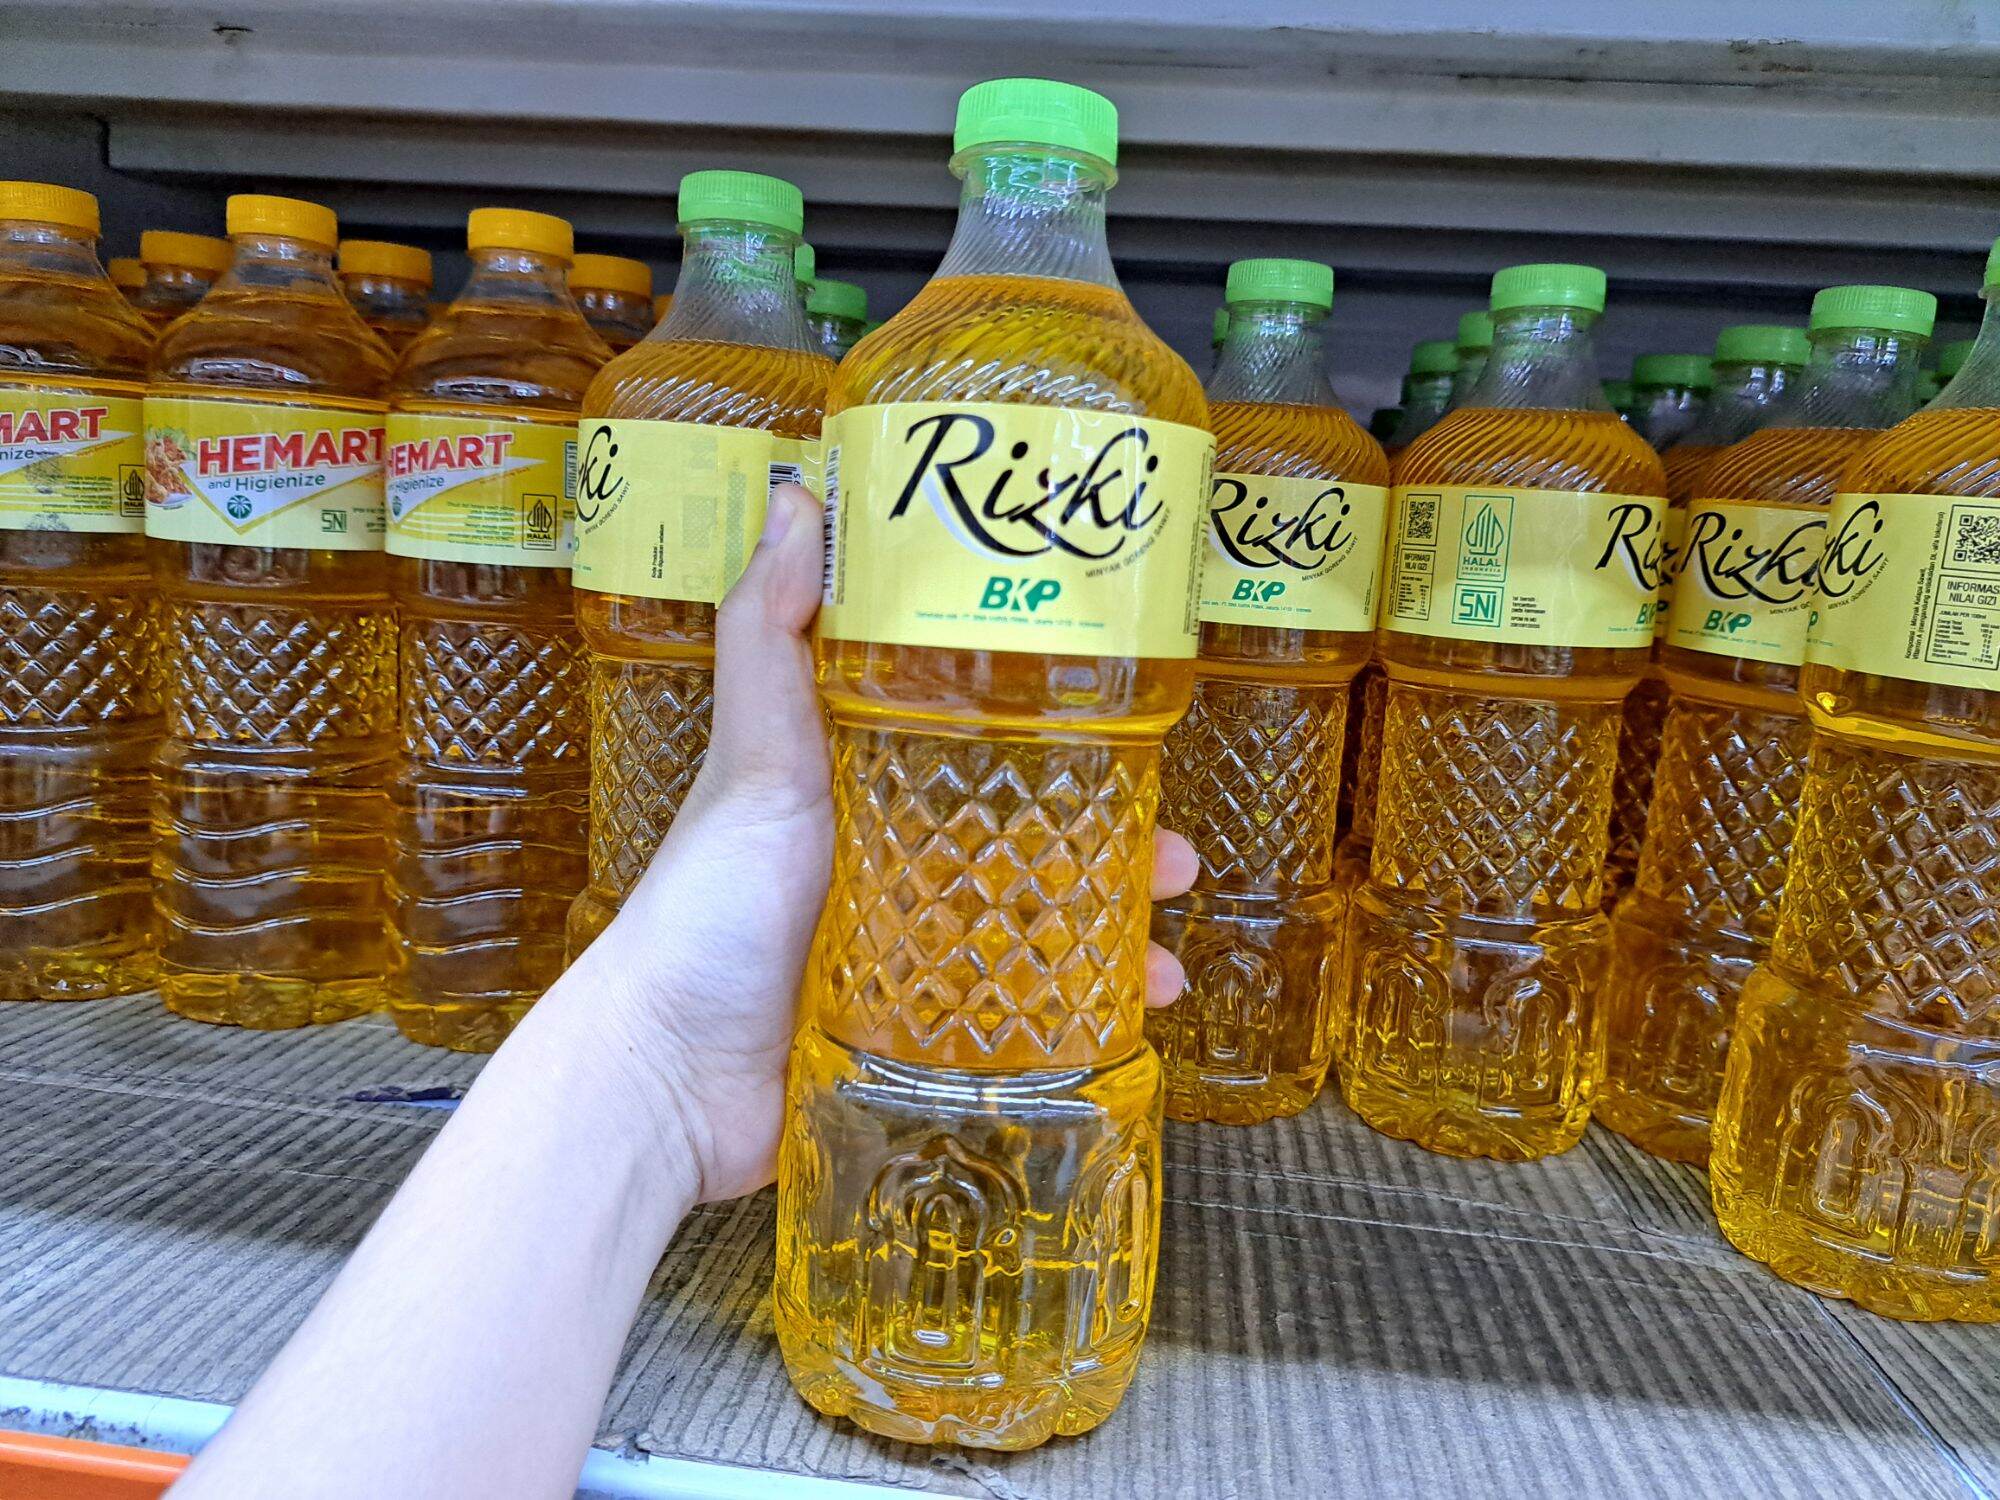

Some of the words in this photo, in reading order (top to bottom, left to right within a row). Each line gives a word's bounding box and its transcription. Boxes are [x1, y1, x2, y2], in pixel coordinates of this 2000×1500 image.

[198, 427, 386, 476] HEMART
[208, 478, 231, 490] and
[235, 472, 326, 493] Higienize
[889, 413, 1163, 560] Rizki
[321, 512, 347, 531] SNI
[1210, 479, 1352, 570] Rizki
[1463, 556, 1501, 567] HALAL
[979, 576, 1061, 613] BKP
[1232, 578, 1286, 602] BKP
[1948, 593, 1975, 604] NILAI
[1977, 595, 1998, 606] GIZI
[1458, 592, 1497, 619] SNI
[1703, 609, 1752, 633] BKP
